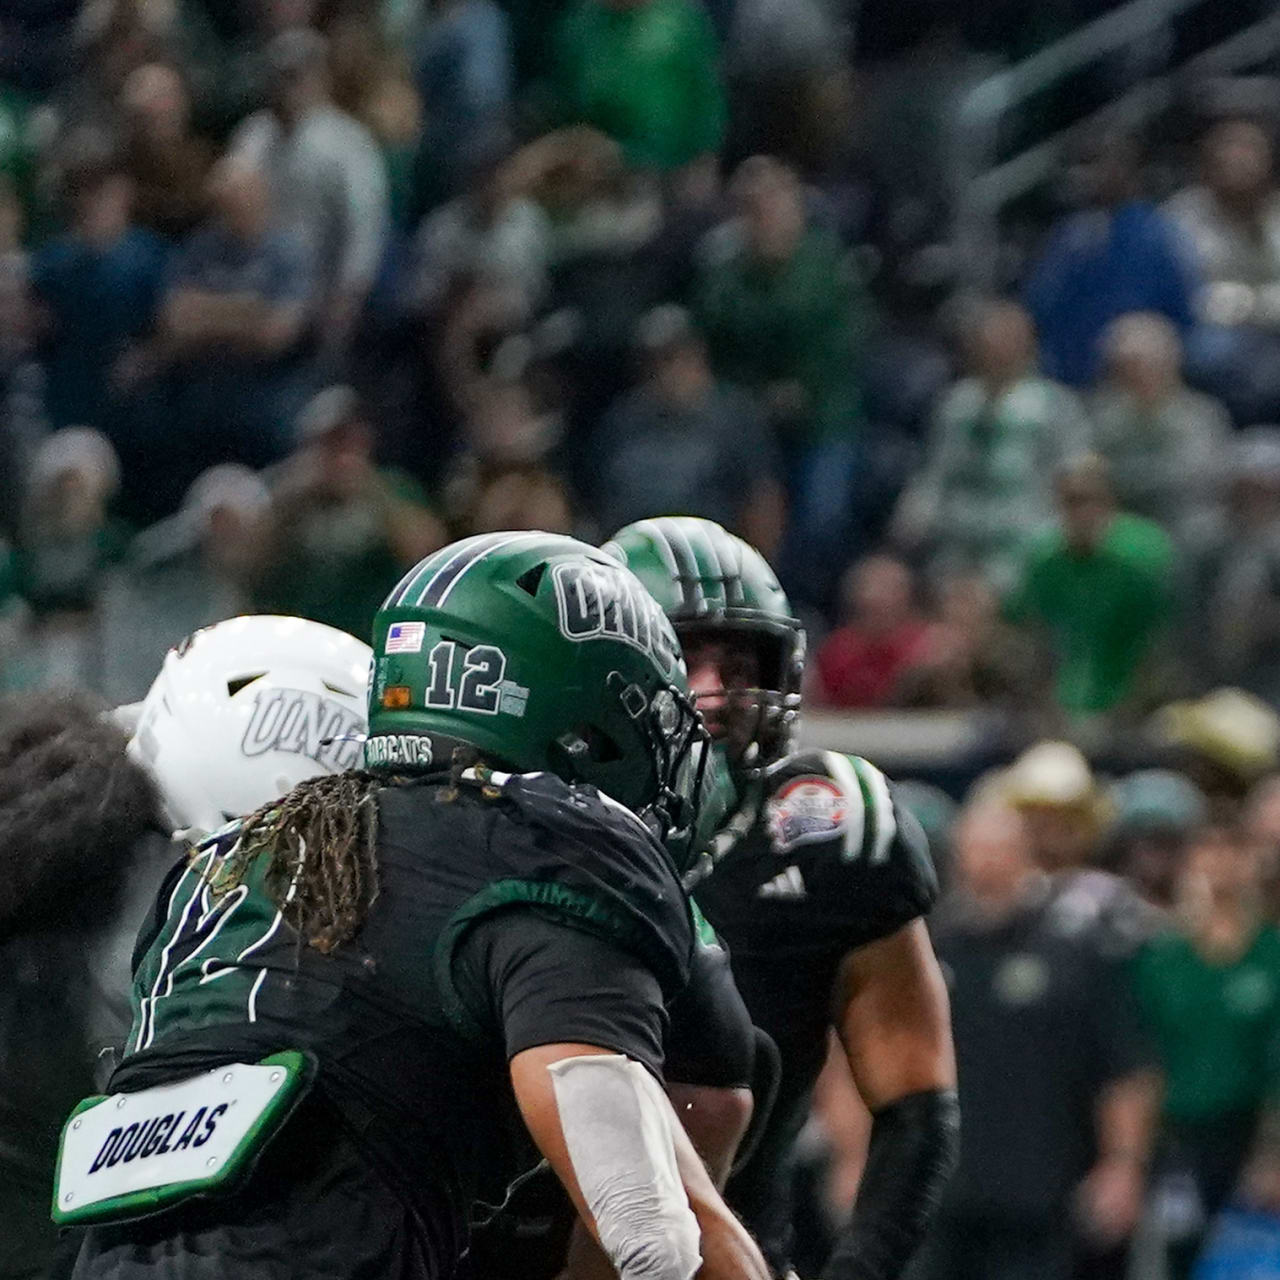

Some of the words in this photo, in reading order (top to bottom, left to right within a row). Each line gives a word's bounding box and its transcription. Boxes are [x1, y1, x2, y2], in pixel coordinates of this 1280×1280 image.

[425, 640, 506, 716] 12
[242, 687, 369, 774] UNL
[87, 1102, 229, 1175] DOUGLAS
